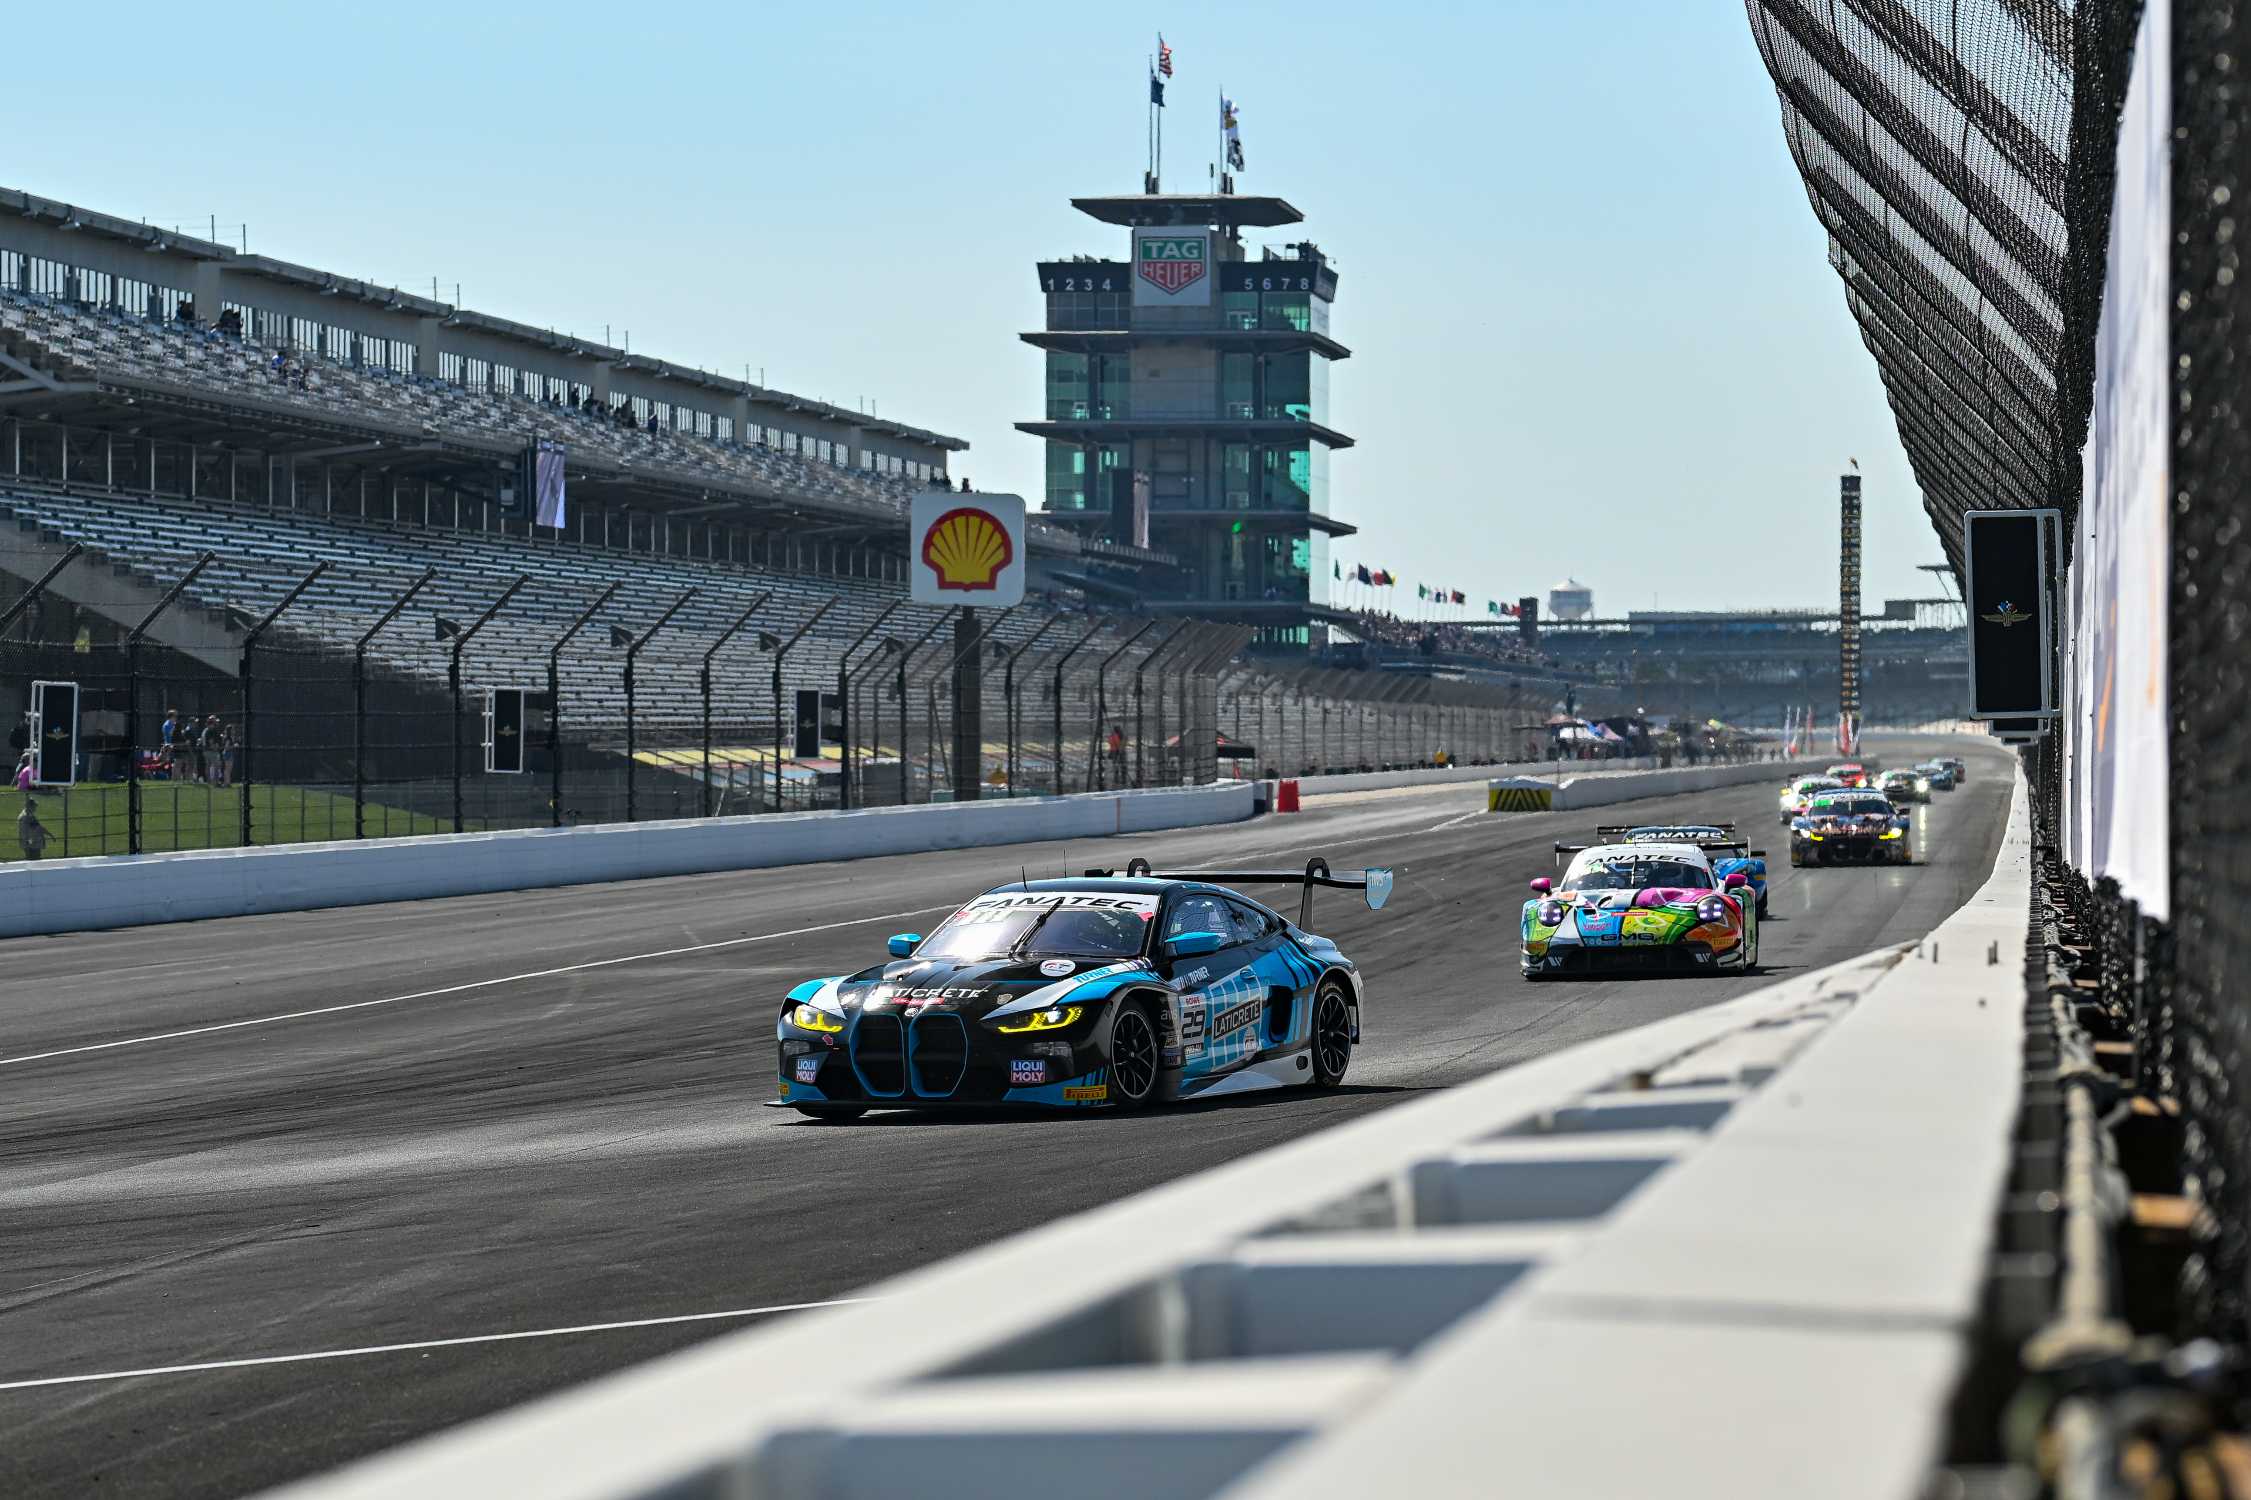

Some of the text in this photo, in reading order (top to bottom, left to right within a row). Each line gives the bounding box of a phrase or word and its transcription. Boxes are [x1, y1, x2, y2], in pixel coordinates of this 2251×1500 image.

[1144, 242, 1199, 258] TAG
[1144, 263, 1201, 288] HEUER
[1048, 279, 1111, 290] 1 2 3 4
[1244, 278, 1309, 290] 5 6 7 8
[1587, 854, 1692, 866] ANATEC
[969, 896, 1143, 911] FANATEC
[884, 987, 982, 998] TICRETE
[1215, 1001, 1260, 1038] LATICRETE
[797, 1060, 816, 1070] LIQUI
[1013, 1061, 1043, 1071] LIQUI
[796, 1071, 816, 1081] MOLY
[1013, 1072, 1044, 1081] MOLY
